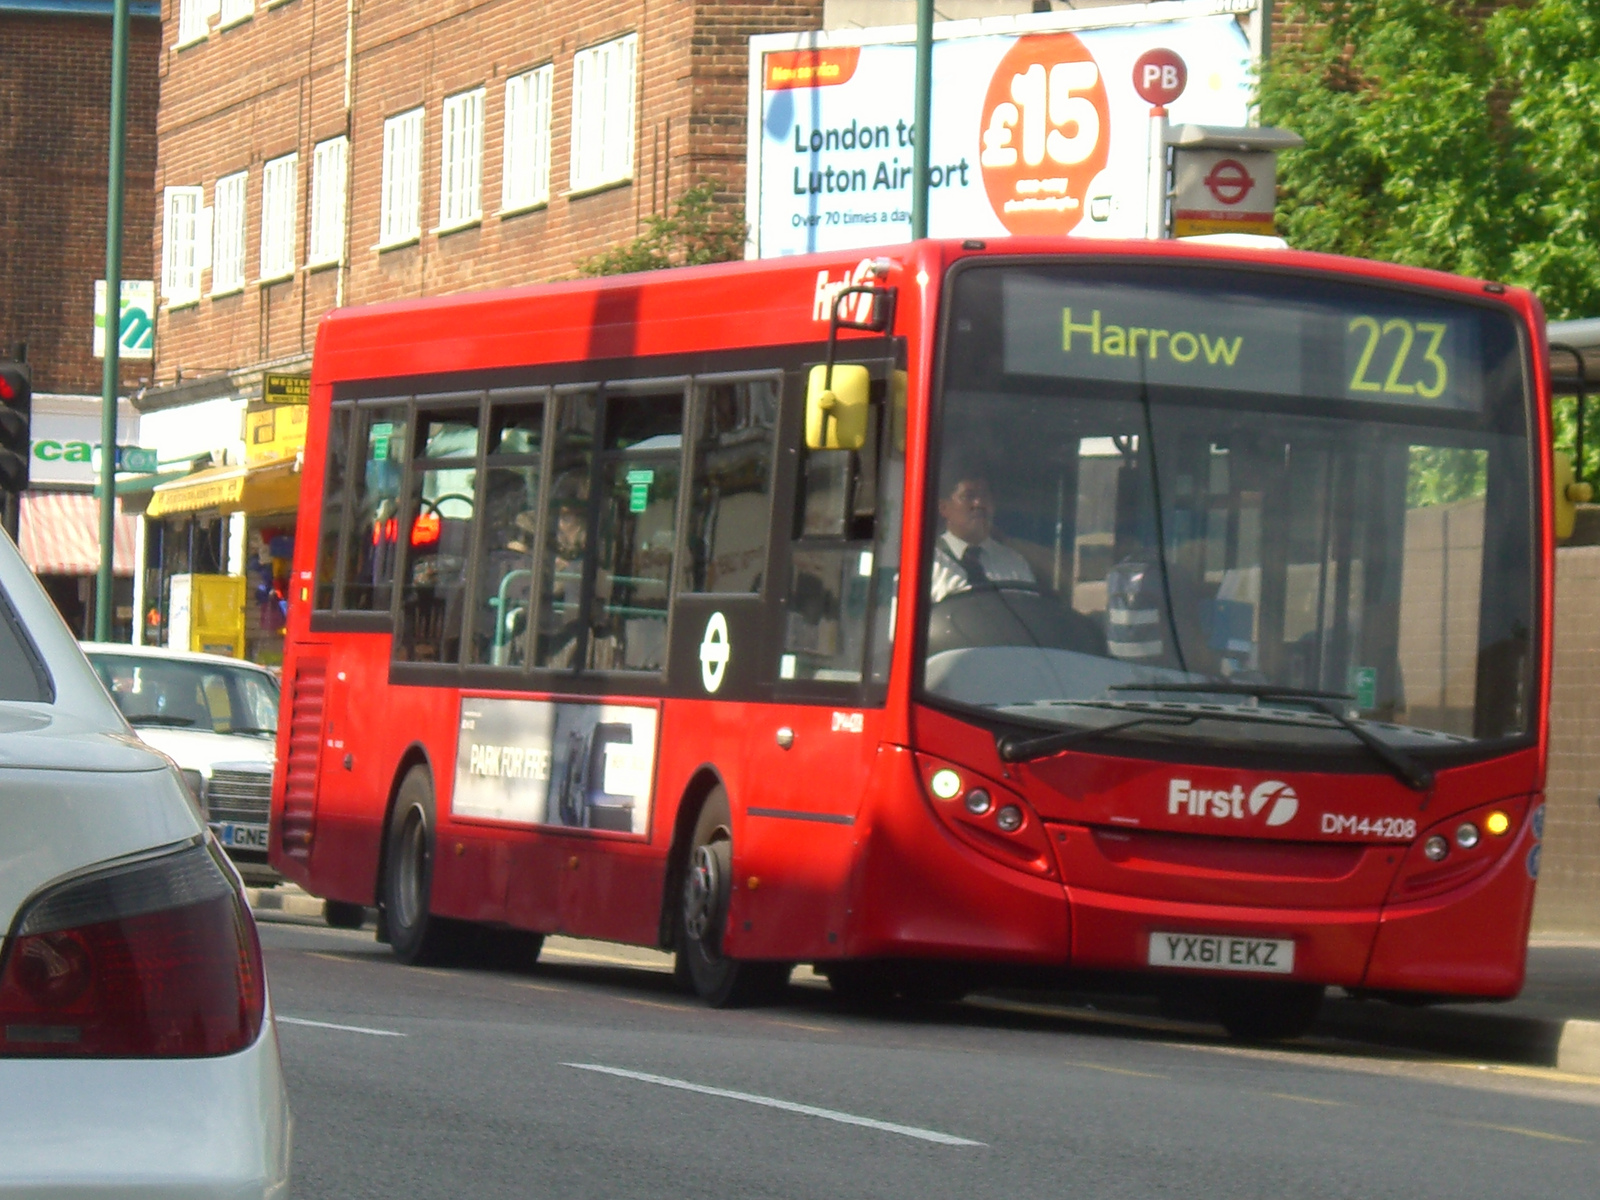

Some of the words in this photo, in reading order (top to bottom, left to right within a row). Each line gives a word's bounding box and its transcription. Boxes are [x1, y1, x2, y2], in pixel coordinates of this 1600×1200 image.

[1143, 64, 1179, 89] PB
[981, 61, 1100, 167] £15
[795, 118, 889, 153] London
[794, 160, 866, 195] Luton
[873, 157, 969, 190] Airort
[792, 213, 821, 227] Over
[825, 211, 840, 225] 70
[843, 208, 877, 224] times
[881, 212, 888, 222] a
[1062, 307, 1244, 366] Harrow
[1348, 315, 1448, 399] 223
[501, 746, 523, 778] FOR
[1168, 779, 1245, 819] First
[1321, 813, 1416, 839] DM44208
[1167, 936, 1222, 963] YX61
[1229, 940, 1278, 967] EKZ
